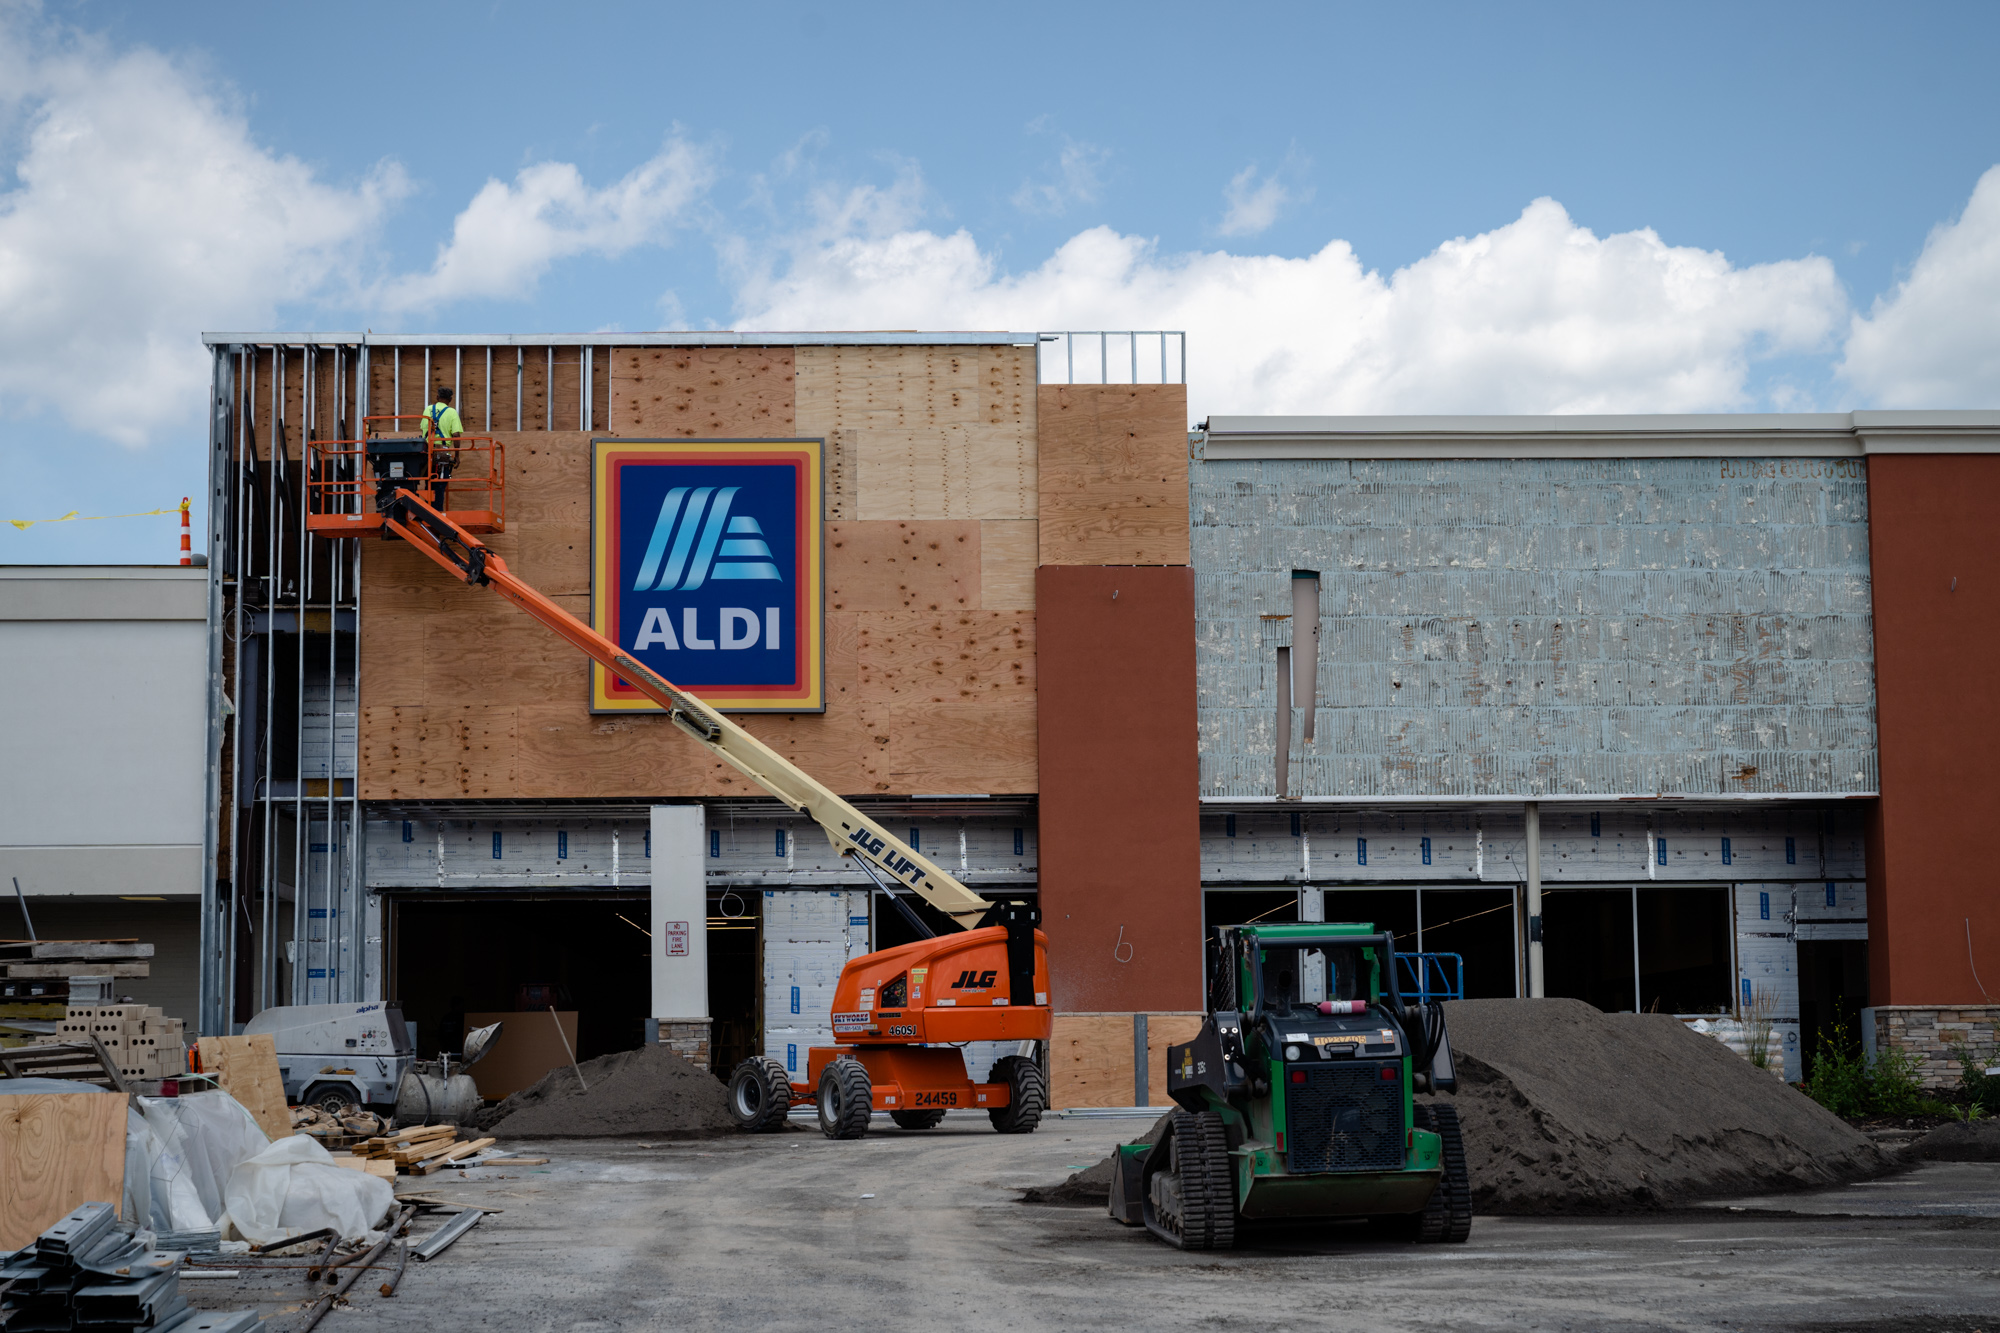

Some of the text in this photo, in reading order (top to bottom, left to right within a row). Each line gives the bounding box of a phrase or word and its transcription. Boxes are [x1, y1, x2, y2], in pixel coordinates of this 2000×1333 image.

[632, 607, 780, 650] ALDI
[848, 827, 886, 857] JLG
[882, 849, 927, 885] LIFT
[951, 970, 998, 988] JLG
[356, 1004, 379, 1013] alpha
[834, 1013, 868, 1023] SKYWORKS
[888, 1025, 917, 1036] 460SJ
[915, 1092, 957, 1105] 24459
